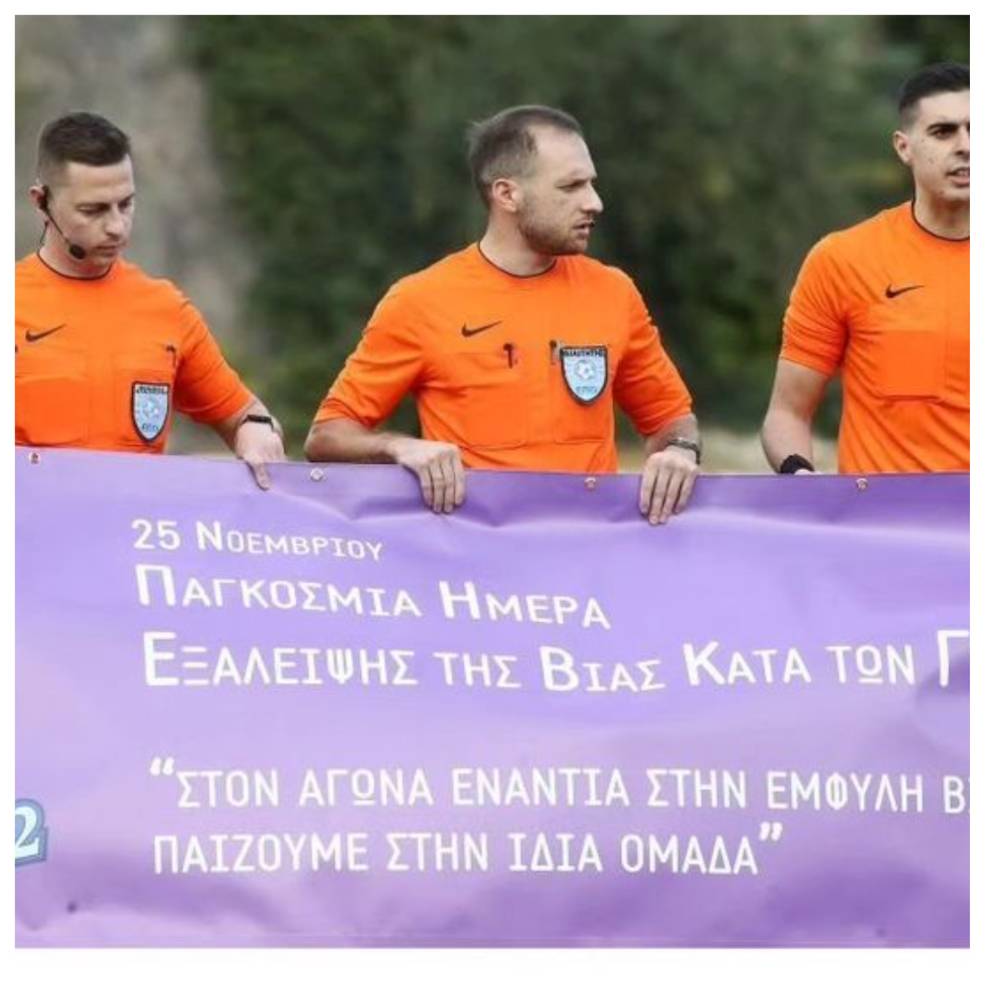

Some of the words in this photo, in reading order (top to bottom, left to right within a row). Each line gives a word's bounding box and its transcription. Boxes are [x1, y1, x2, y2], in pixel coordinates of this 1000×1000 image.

[131, 518, 181, 551] 25
[195, 520, 382, 561] ΝΟΕΜΒΡΙΟΥ
[135, 562, 422, 617] ΠΑΓΚΟΣΜΙΑ
[438, 580, 611, 630] ΗΜΕΡΑ
[143, 630, 418, 686] ΕΞΑΛΕΙΨΗΣ
[433, 651, 521, 688] ΤΗΣ
[539, 645, 666, 693] ΒΙΑΣ
[682, 640, 812, 686] ΚΑΤΑ
[824, 643, 915, 685] ΤΩΝ
[298, 767, 434, 806] ΑΓΩΝΑ
[451, 767, 630, 807] ΕΝΑΝΤΙΑ
[645, 768, 747, 809] ΣΤΗΝ
[765, 770, 923, 812] ΕΜΦΥΛΗ
[942, 774, 970, 814] Β
[153, 833, 370, 875] ΠΑΙΖΟΥΜΕ
[385, 831, 488, 872] ΣΤΗΝ
[507, 832, 604, 873] ΙΔΙΑ
